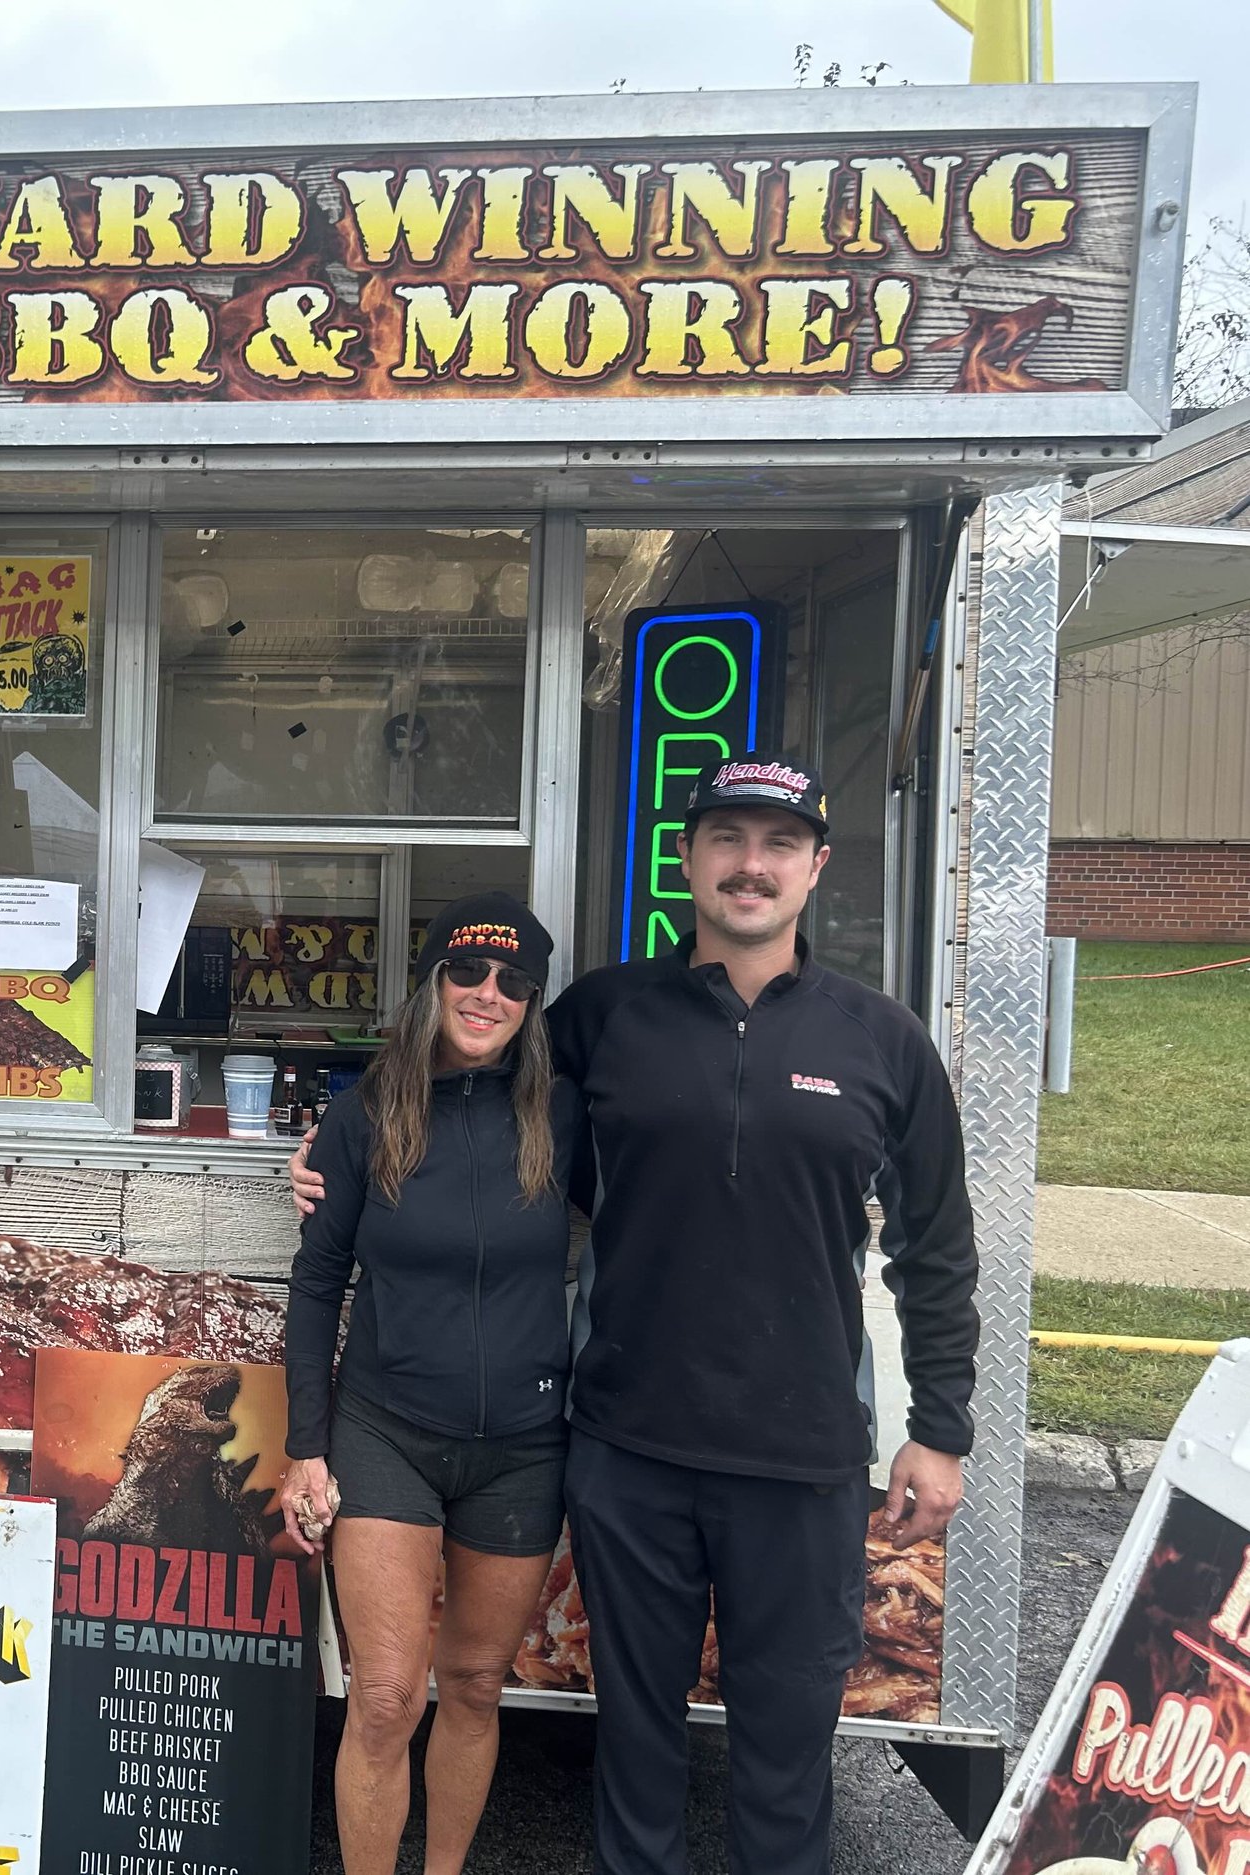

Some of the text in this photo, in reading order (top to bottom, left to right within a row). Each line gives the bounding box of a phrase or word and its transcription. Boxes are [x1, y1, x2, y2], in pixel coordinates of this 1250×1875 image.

[337, 152, 1078, 267] WINNING
[245, 285, 360, 380] &
[390, 278, 914, 379] MORE!
[711, 762, 811, 791] Hendrick
[646, 635, 739, 959] OPEN
[452, 923, 518, 940] RANDY'S
[53, 1536, 302, 1638] GODZILLA
[114, 1623, 303, 1669] SANDWICH
[114, 1667, 220, 1700] PULLED PORK
[99, 1697, 234, 1733] PULLED CHICKEN
[109, 1728, 222, 1763] BEEF BRISKET
[119, 1760, 207, 1793] BBQ SAUCE
[103, 1790, 221, 1826] MAC & CHEESE
[138, 1826, 183, 1853] SLAW
[80, 1851, 113, 1875] DILL
[120, 1855, 175, 1875] PICKLE
